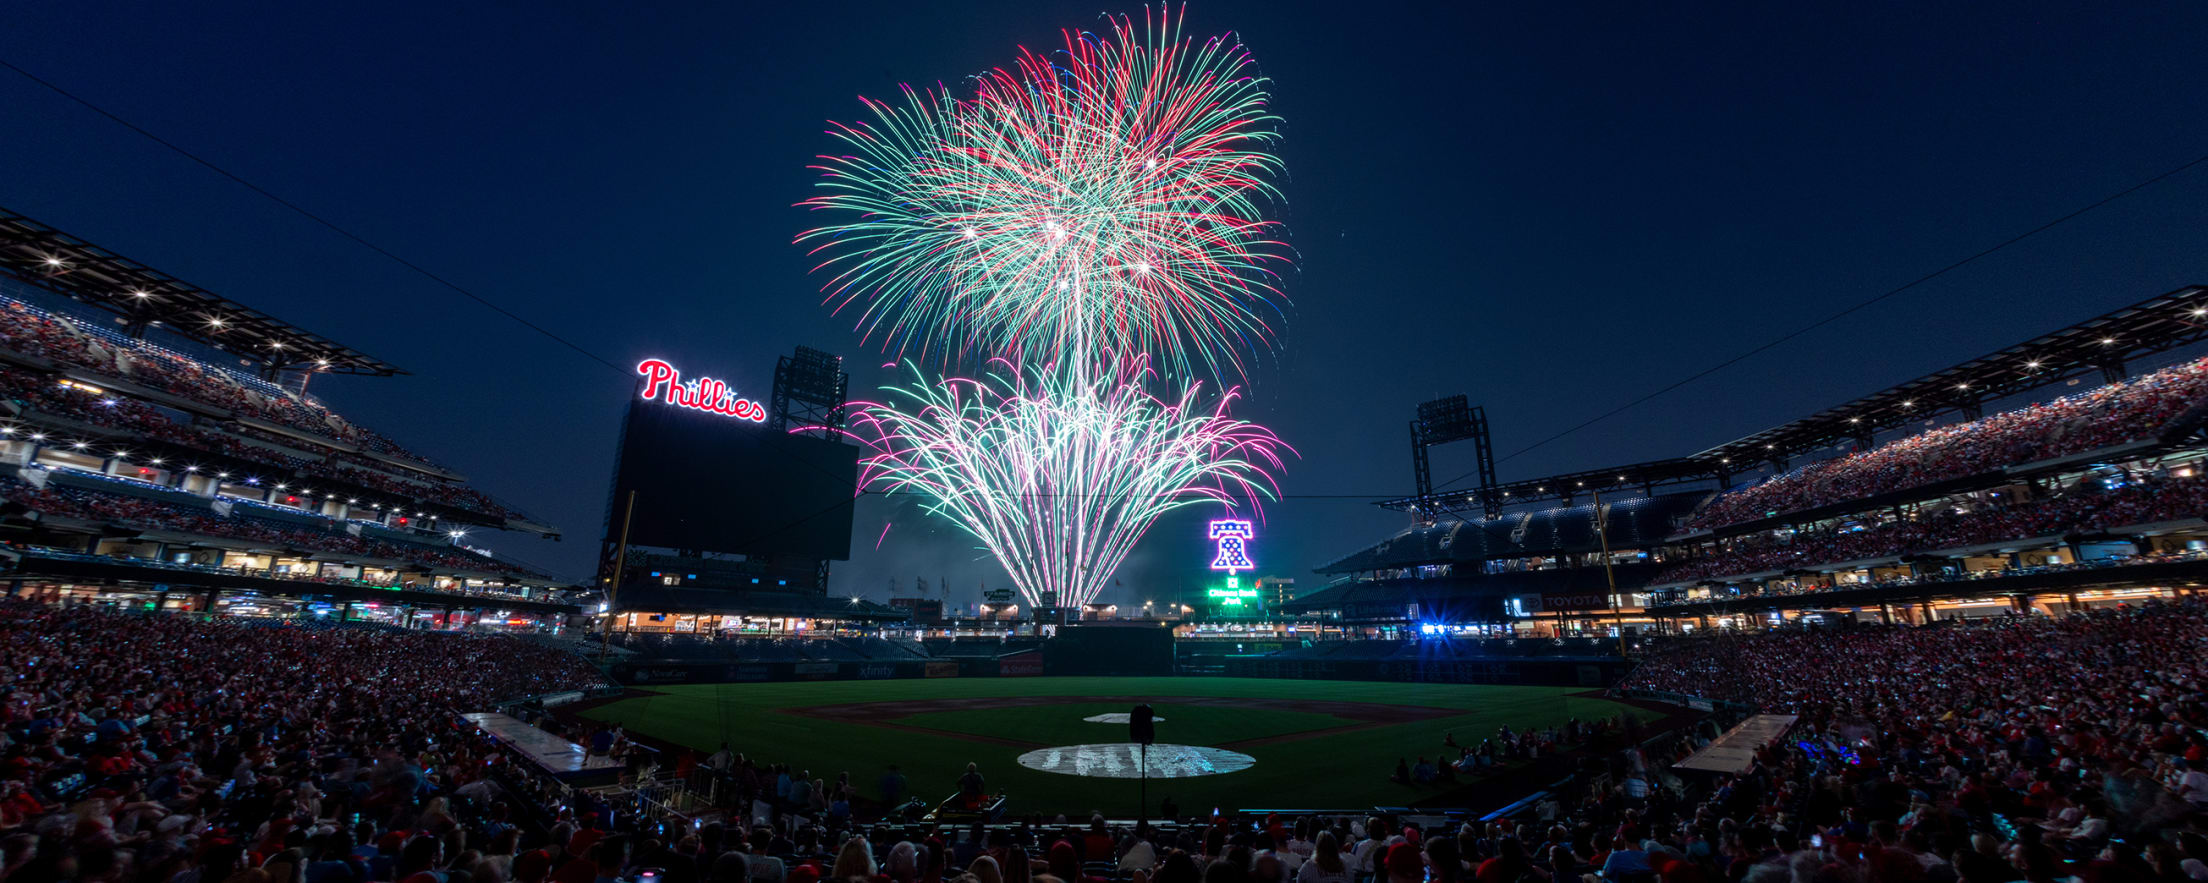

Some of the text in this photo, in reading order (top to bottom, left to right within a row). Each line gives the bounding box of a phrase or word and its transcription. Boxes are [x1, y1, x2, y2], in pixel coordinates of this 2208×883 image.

[637, 358, 766, 423] Phillies
[1544, 594, 1603, 607] TOYOTA
[859, 664, 894, 679] xfinity
